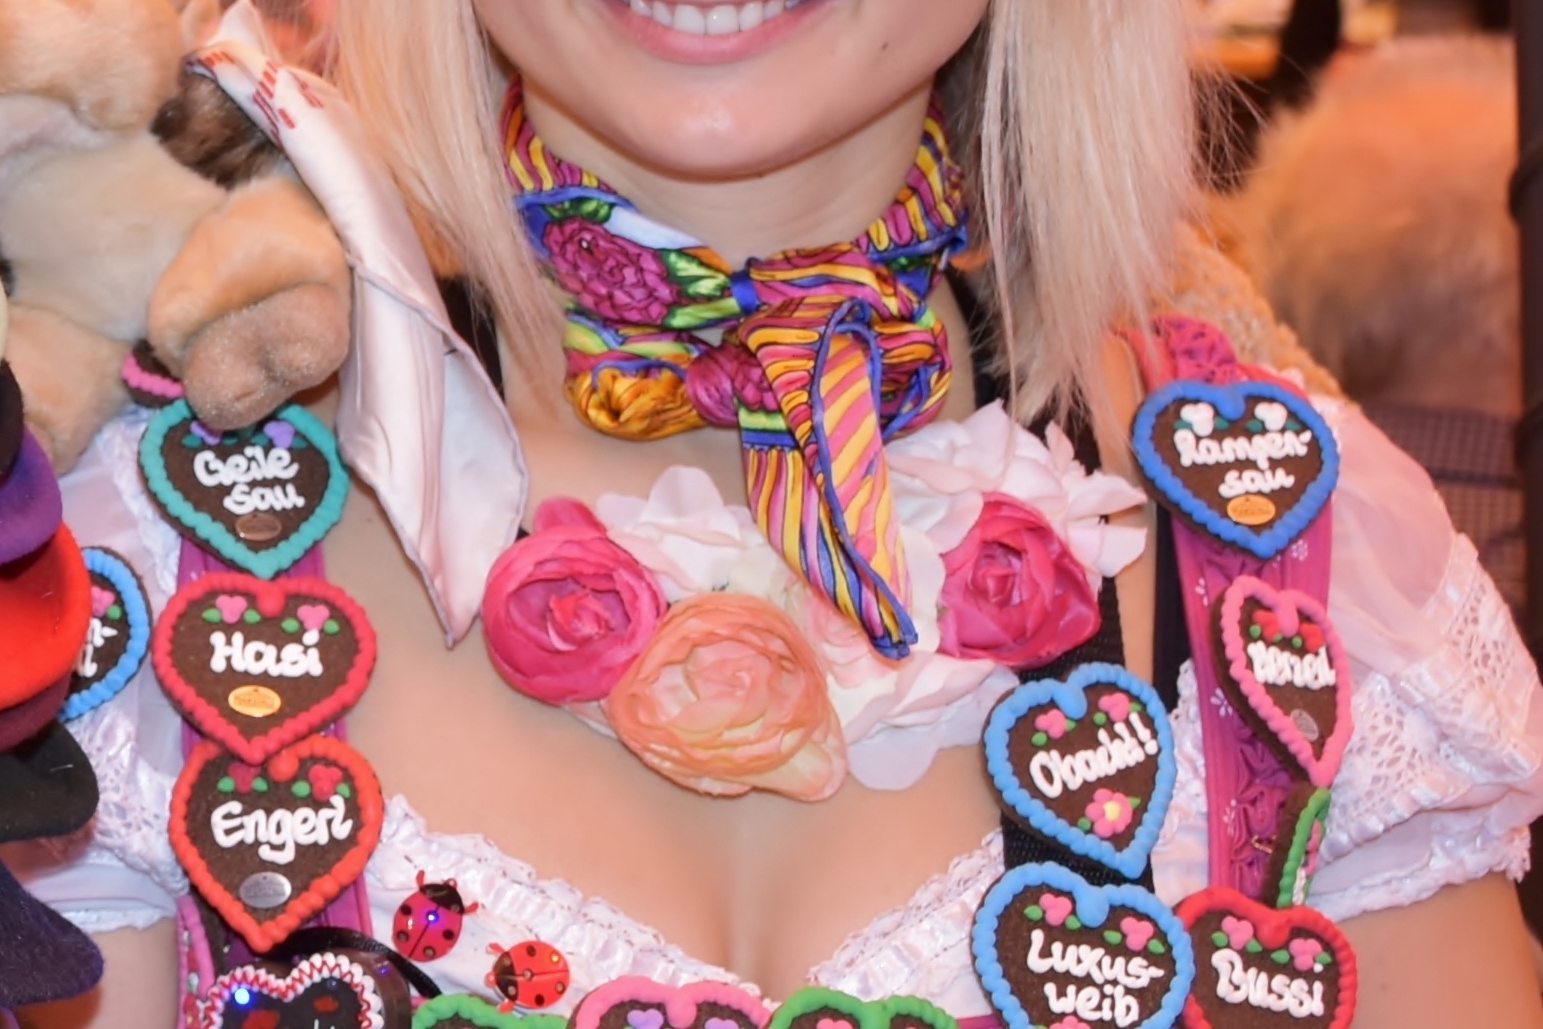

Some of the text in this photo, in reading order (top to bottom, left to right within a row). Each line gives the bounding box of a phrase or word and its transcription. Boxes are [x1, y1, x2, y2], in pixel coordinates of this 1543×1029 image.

[193, 445, 300, 486] Geile
[209, 628, 323, 677] Hasi
[210, 795, 353, 865] Engerl
[1211, 948, 1324, 1018] Bussi
